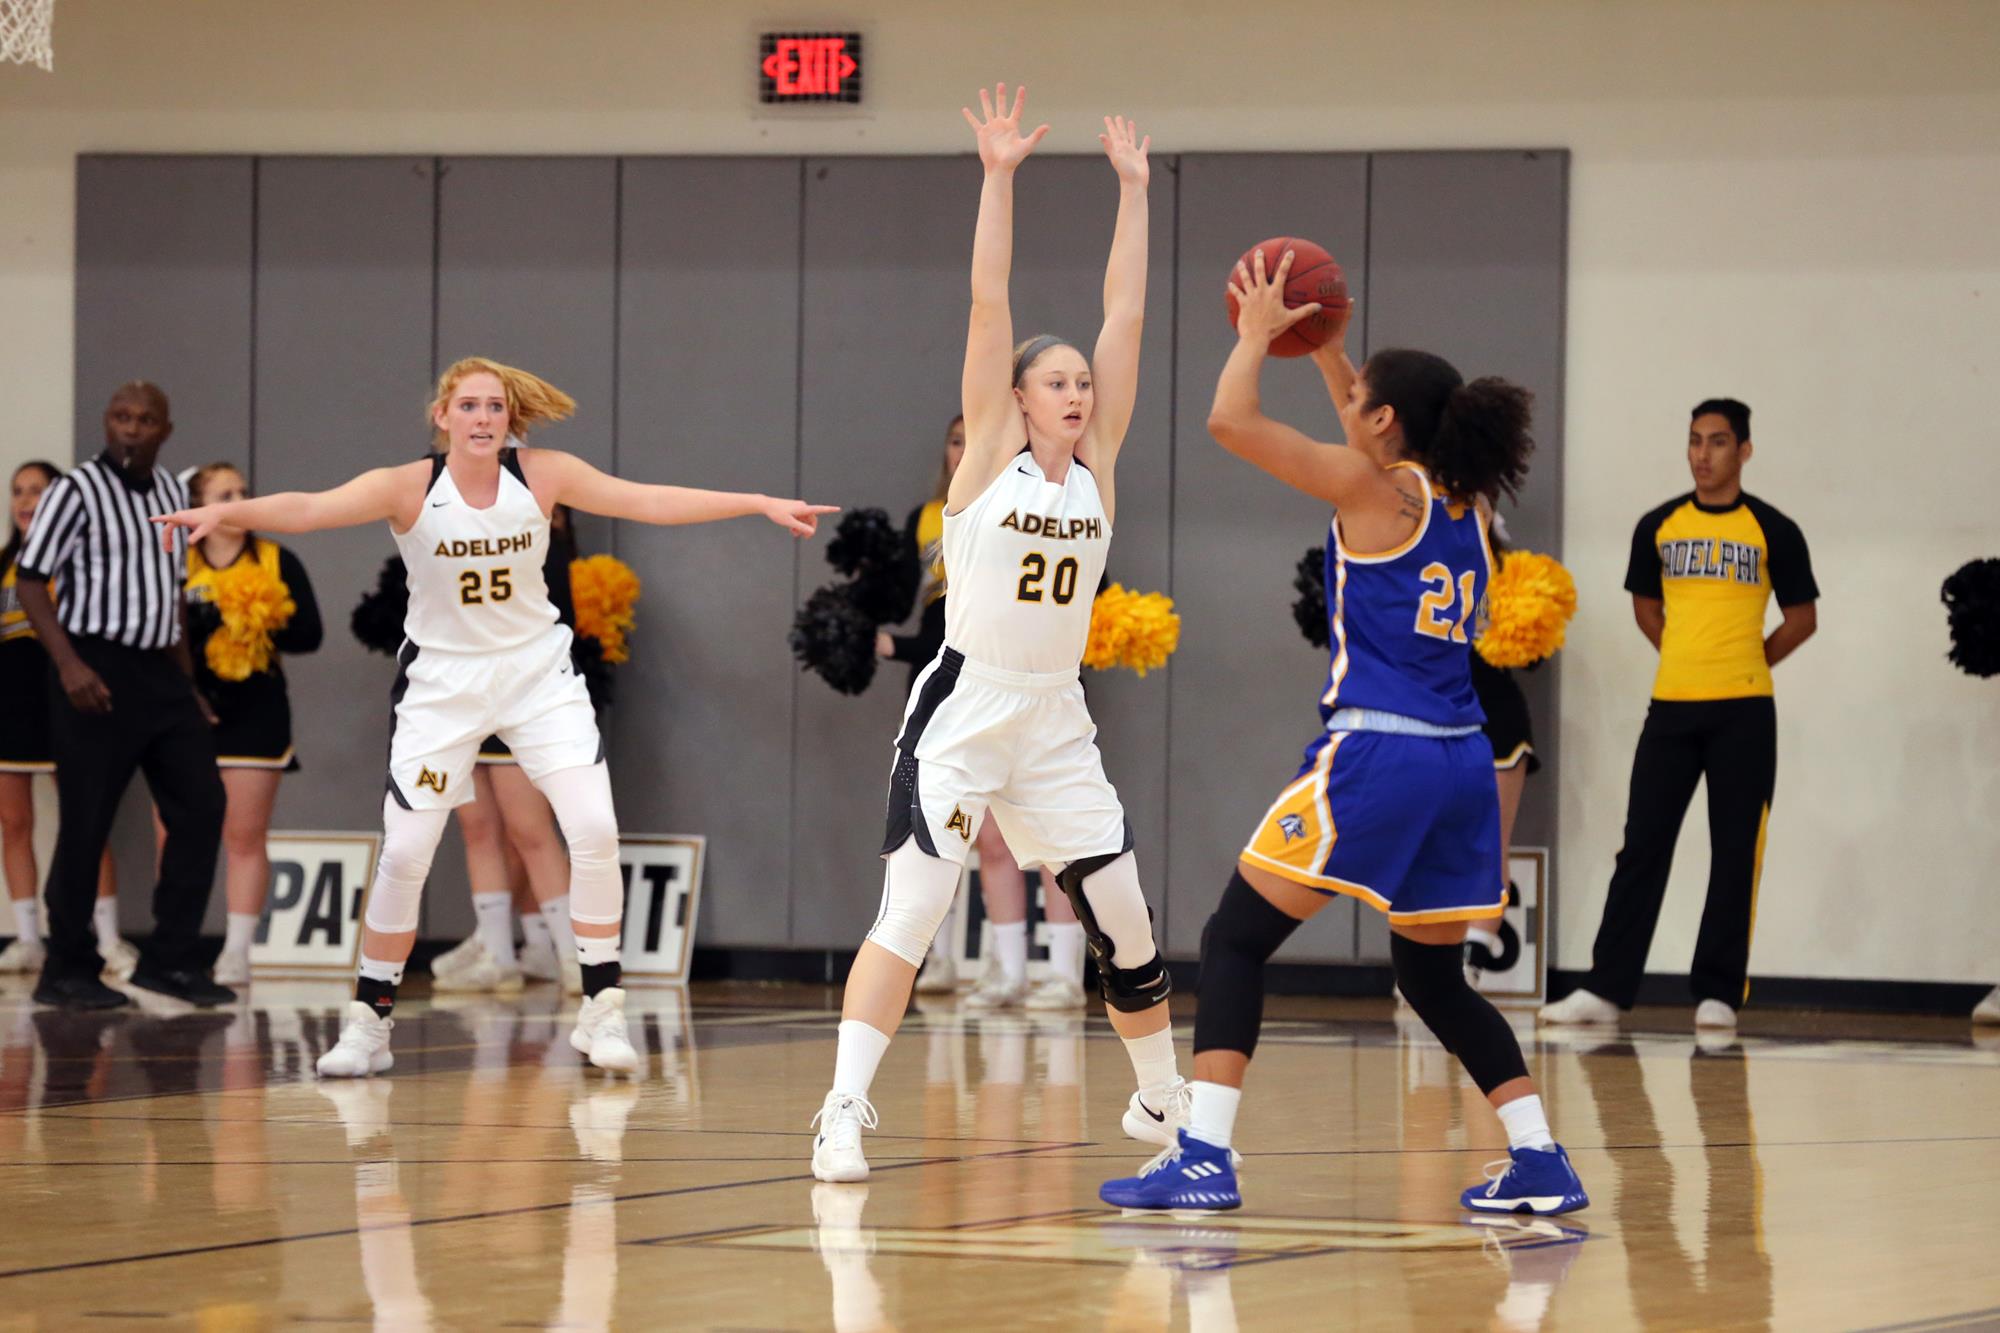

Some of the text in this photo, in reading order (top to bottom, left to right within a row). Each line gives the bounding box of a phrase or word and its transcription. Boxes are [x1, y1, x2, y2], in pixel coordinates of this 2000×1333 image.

[776, 38, 846, 94] EXIT
[434, 531, 532, 557] ADELPHI
[1000, 508, 1102, 541] ADELPHI
[459, 568, 512, 605] 25
[1017, 551, 1079, 605] 20
[1661, 537, 1761, 586] ADELPHI
[1414, 561, 1476, 644] 21
[253, 861, 342, 945] PA
